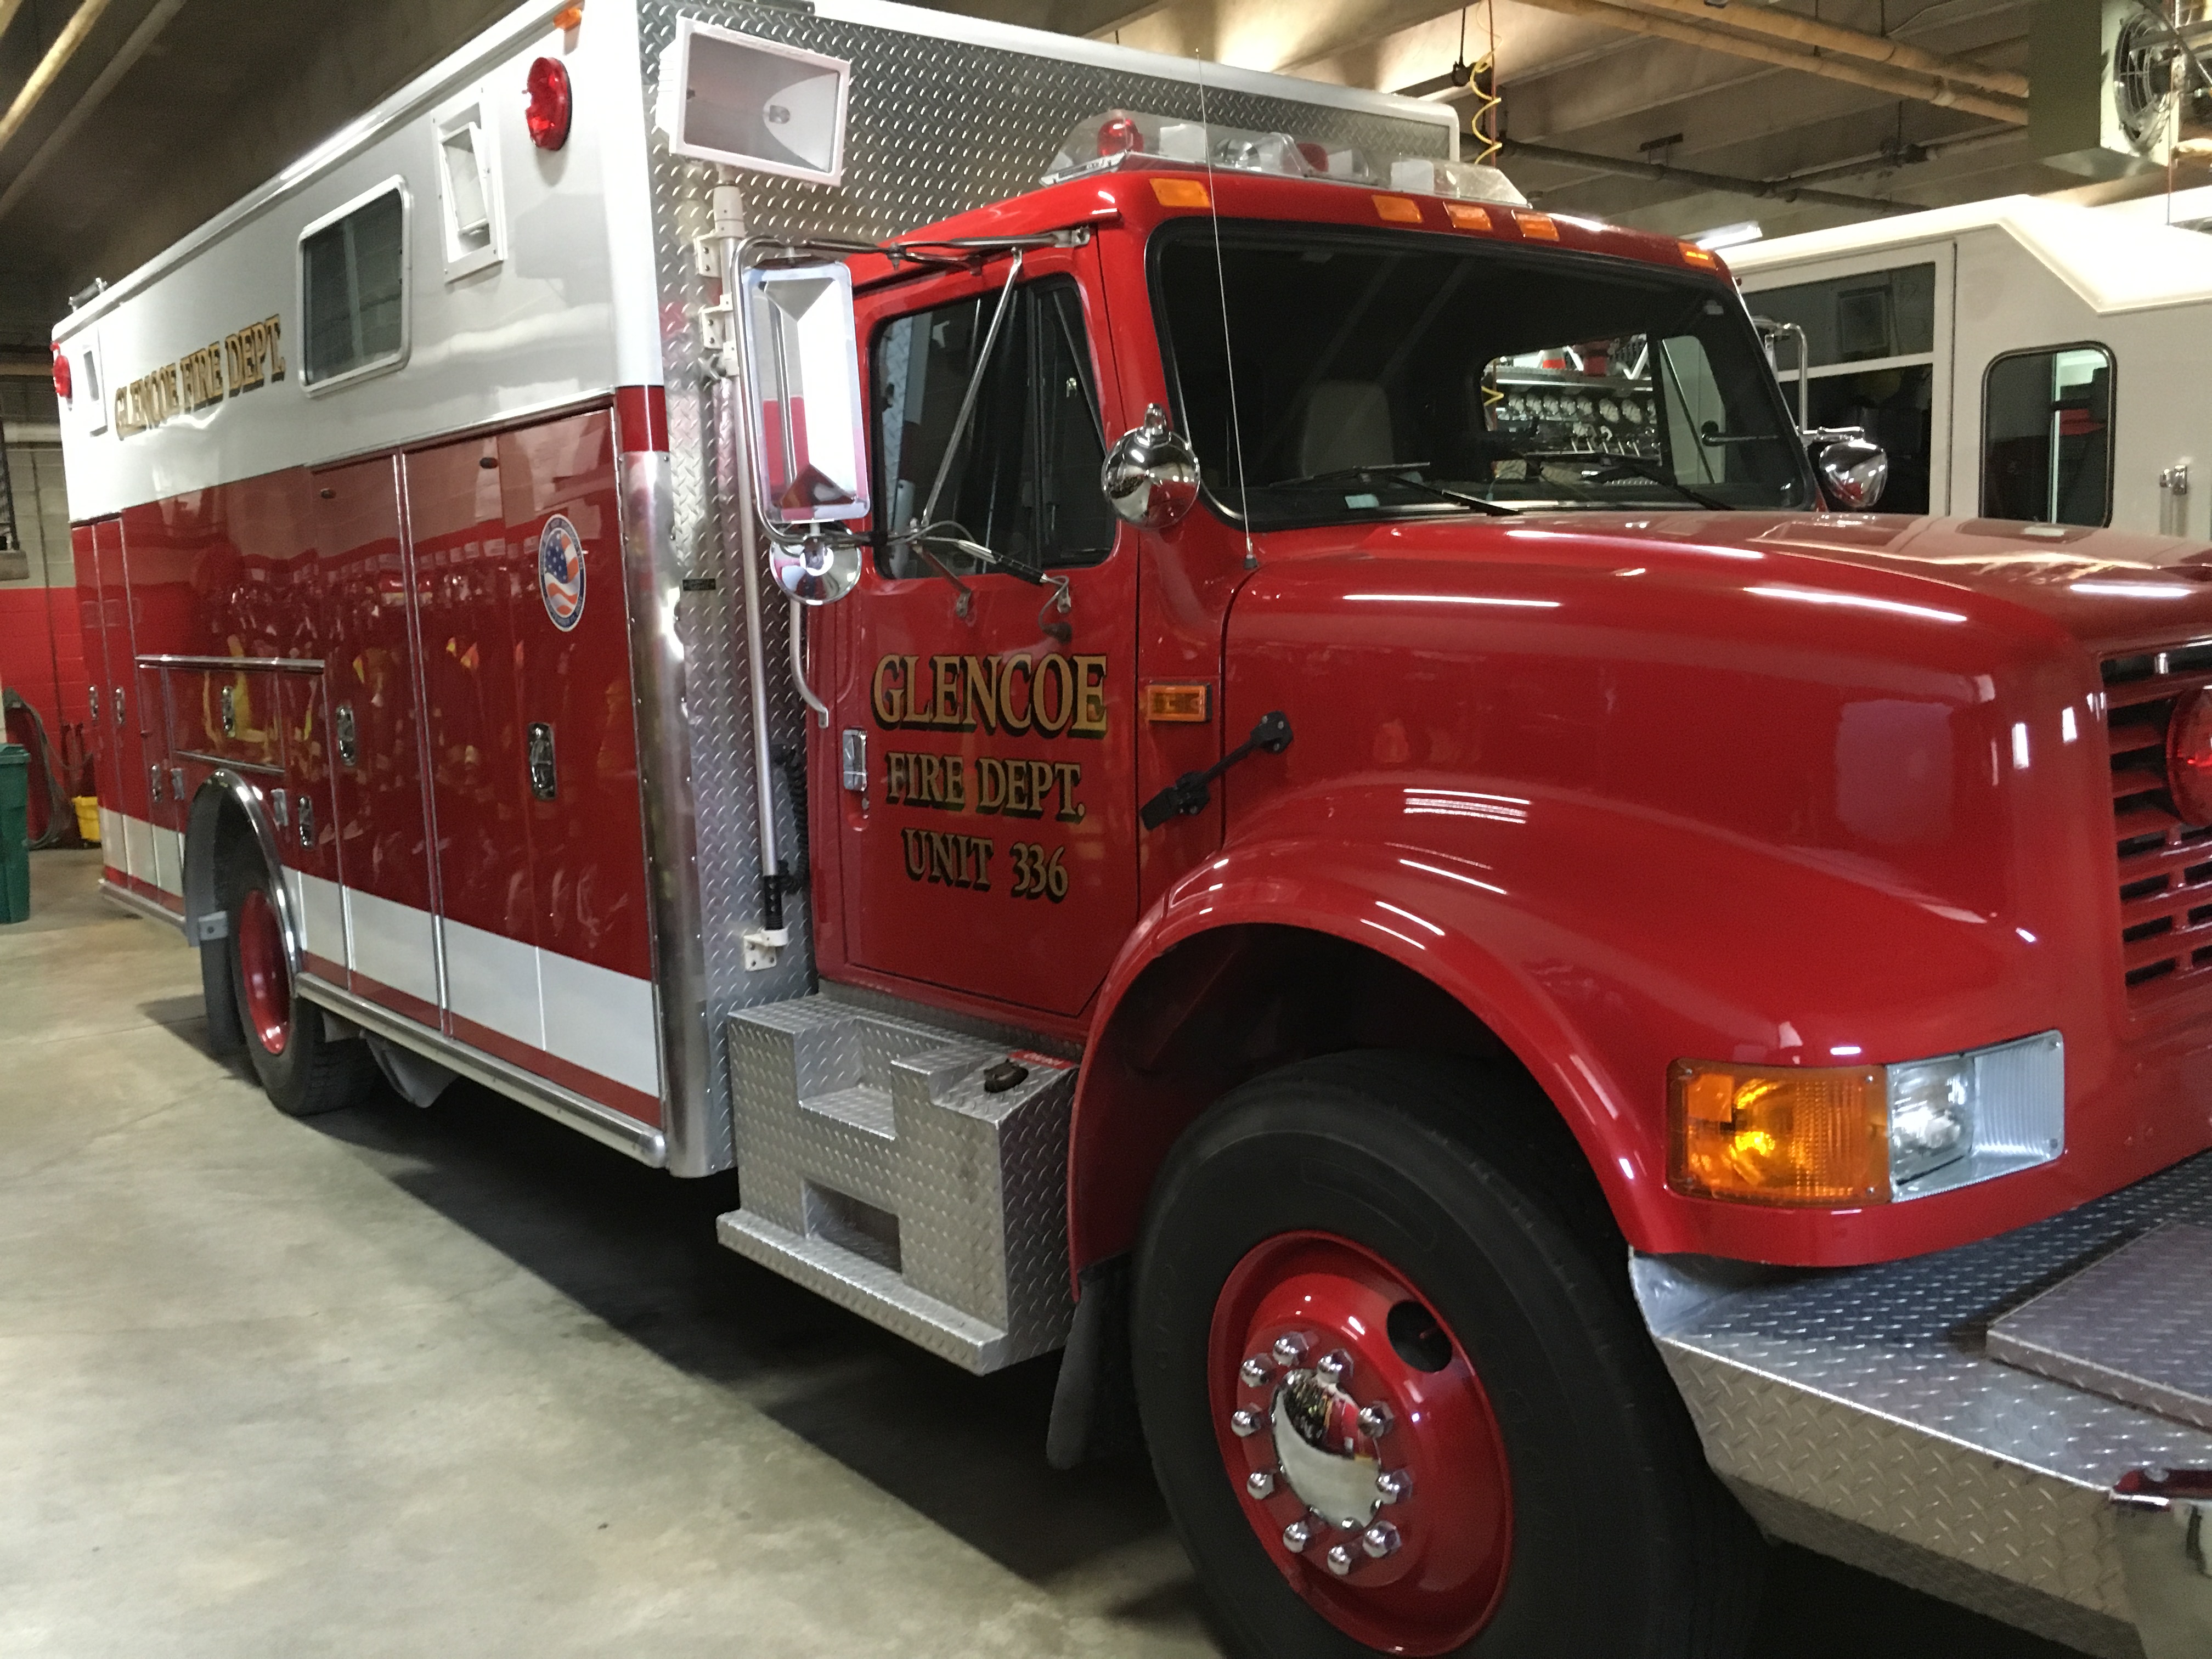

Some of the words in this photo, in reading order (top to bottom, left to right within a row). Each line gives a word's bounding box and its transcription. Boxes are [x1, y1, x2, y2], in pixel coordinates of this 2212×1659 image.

[115, 363, 180, 441] GLENCOE
[180, 341, 224, 414] FIRE
[225, 313, 286, 398] DEPT.
[871, 654, 1107, 739] GLENCOE
[885, 752, 965, 811] FIRE
[975, 758, 1086, 823] DEPT.
[901, 828, 994, 892] UNIT
[1009, 842, 1069, 903] 336
